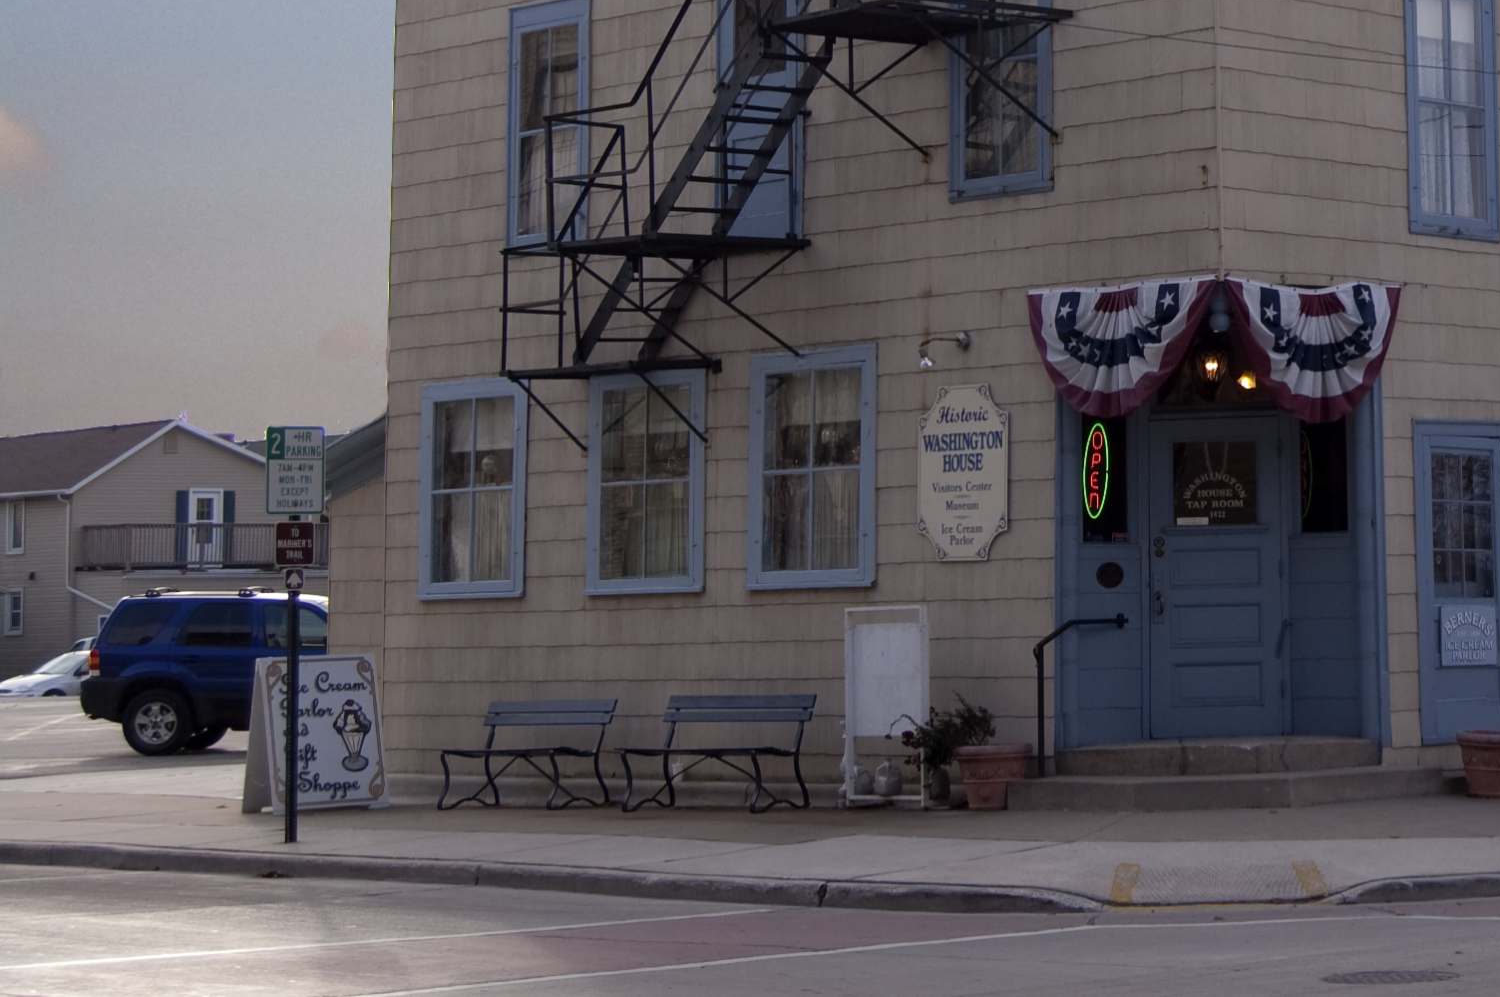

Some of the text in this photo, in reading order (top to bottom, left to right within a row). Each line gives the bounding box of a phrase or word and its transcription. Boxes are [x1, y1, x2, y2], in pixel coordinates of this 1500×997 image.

[936, 406, 989, 425] Historic
[271, 432, 281, 455] 2
[923, 430, 1003, 453] WASHINGTON
[286, 445, 322, 458] PARKING
[942, 453, 984, 473] HOUSE
[1089, 431, 1103, 510] OPEN
[932, 481, 992, 494] Visitors Center
[1183, 471, 1248, 499] WASHINGTON
[280, 487, 310, 497] EXCEPT
[1197, 489, 1233, 499] HOUSE
[276, 498, 314, 508] HOLIDAYS
[945, 501, 980, 512] Museum
[1185, 499, 1244, 510] TAP ROOM
[291, 528, 300, 538] TO
[941, 523, 983, 535] Ice Cream
[950, 535, 975, 546] Parlor
[1445, 641, 1496, 651] ICE CREAM
[1451, 650, 1487, 659] PARLOR
[315, 671, 367, 693] Cream
[284, 743, 317, 770] ift
[297, 771, 360, 800] Shoppe
